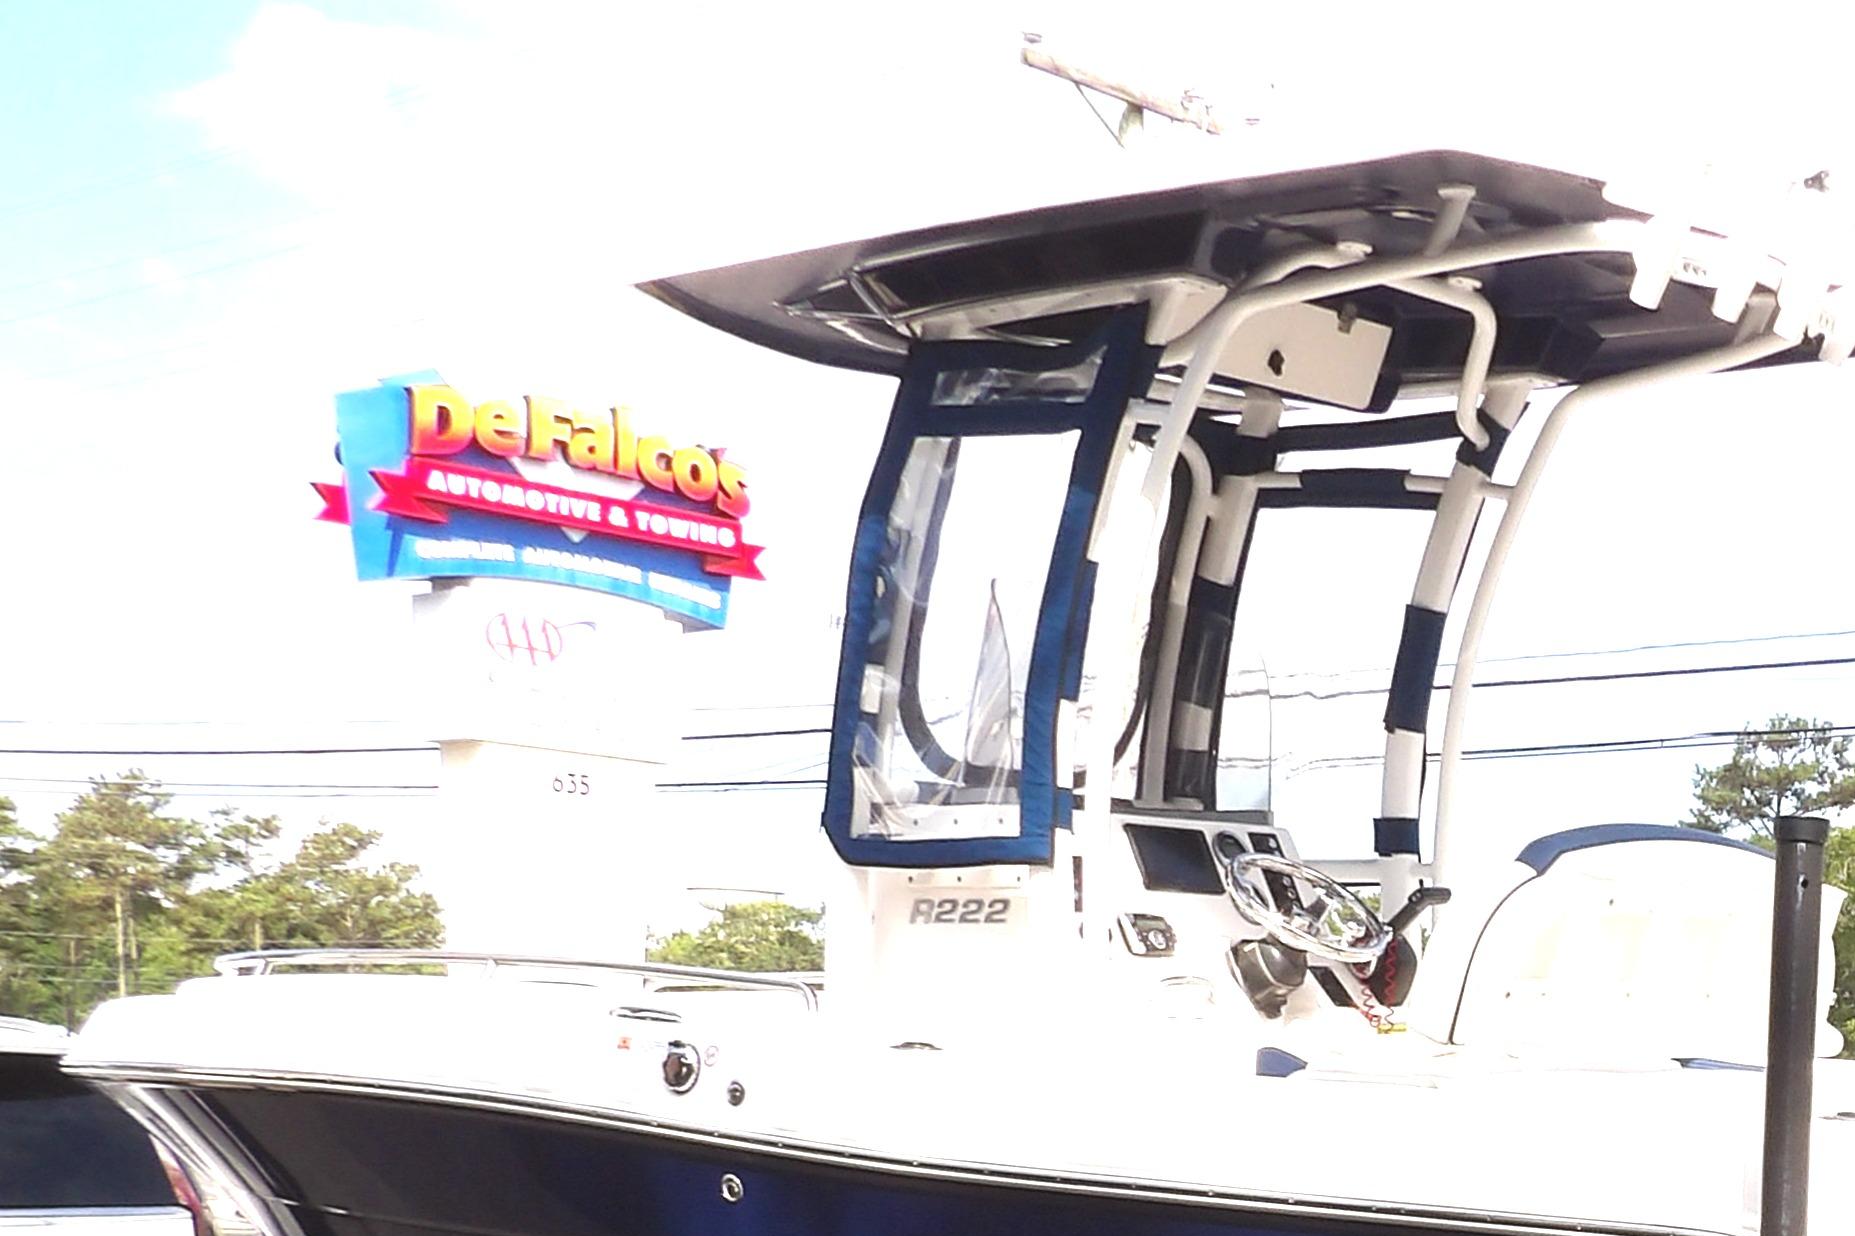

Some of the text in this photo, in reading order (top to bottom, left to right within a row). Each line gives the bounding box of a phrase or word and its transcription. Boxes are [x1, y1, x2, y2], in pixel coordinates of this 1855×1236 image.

[427, 470, 737, 549] AUTOMOTIVE & TOWING
